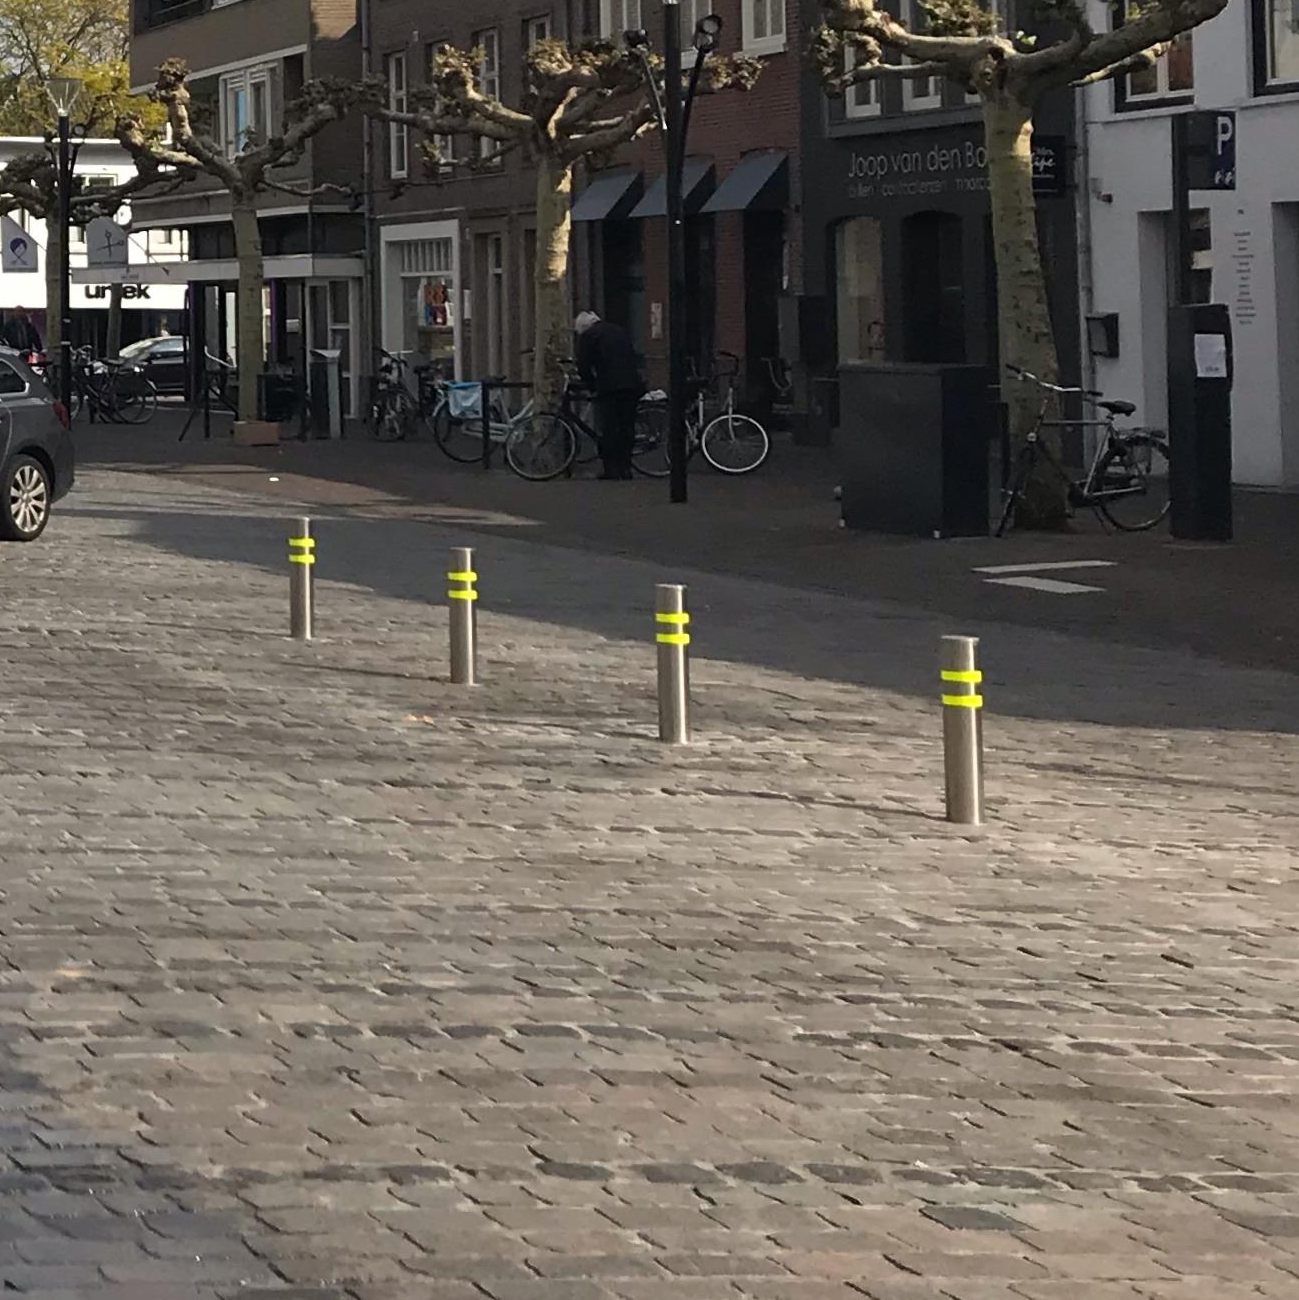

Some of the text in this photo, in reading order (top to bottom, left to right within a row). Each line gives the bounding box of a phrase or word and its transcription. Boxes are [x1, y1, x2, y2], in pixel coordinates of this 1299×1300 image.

[1216, 115, 1234, 155] P
[848, 141, 989, 179] Joop van den Bo
[84, 283, 151, 300] unek
